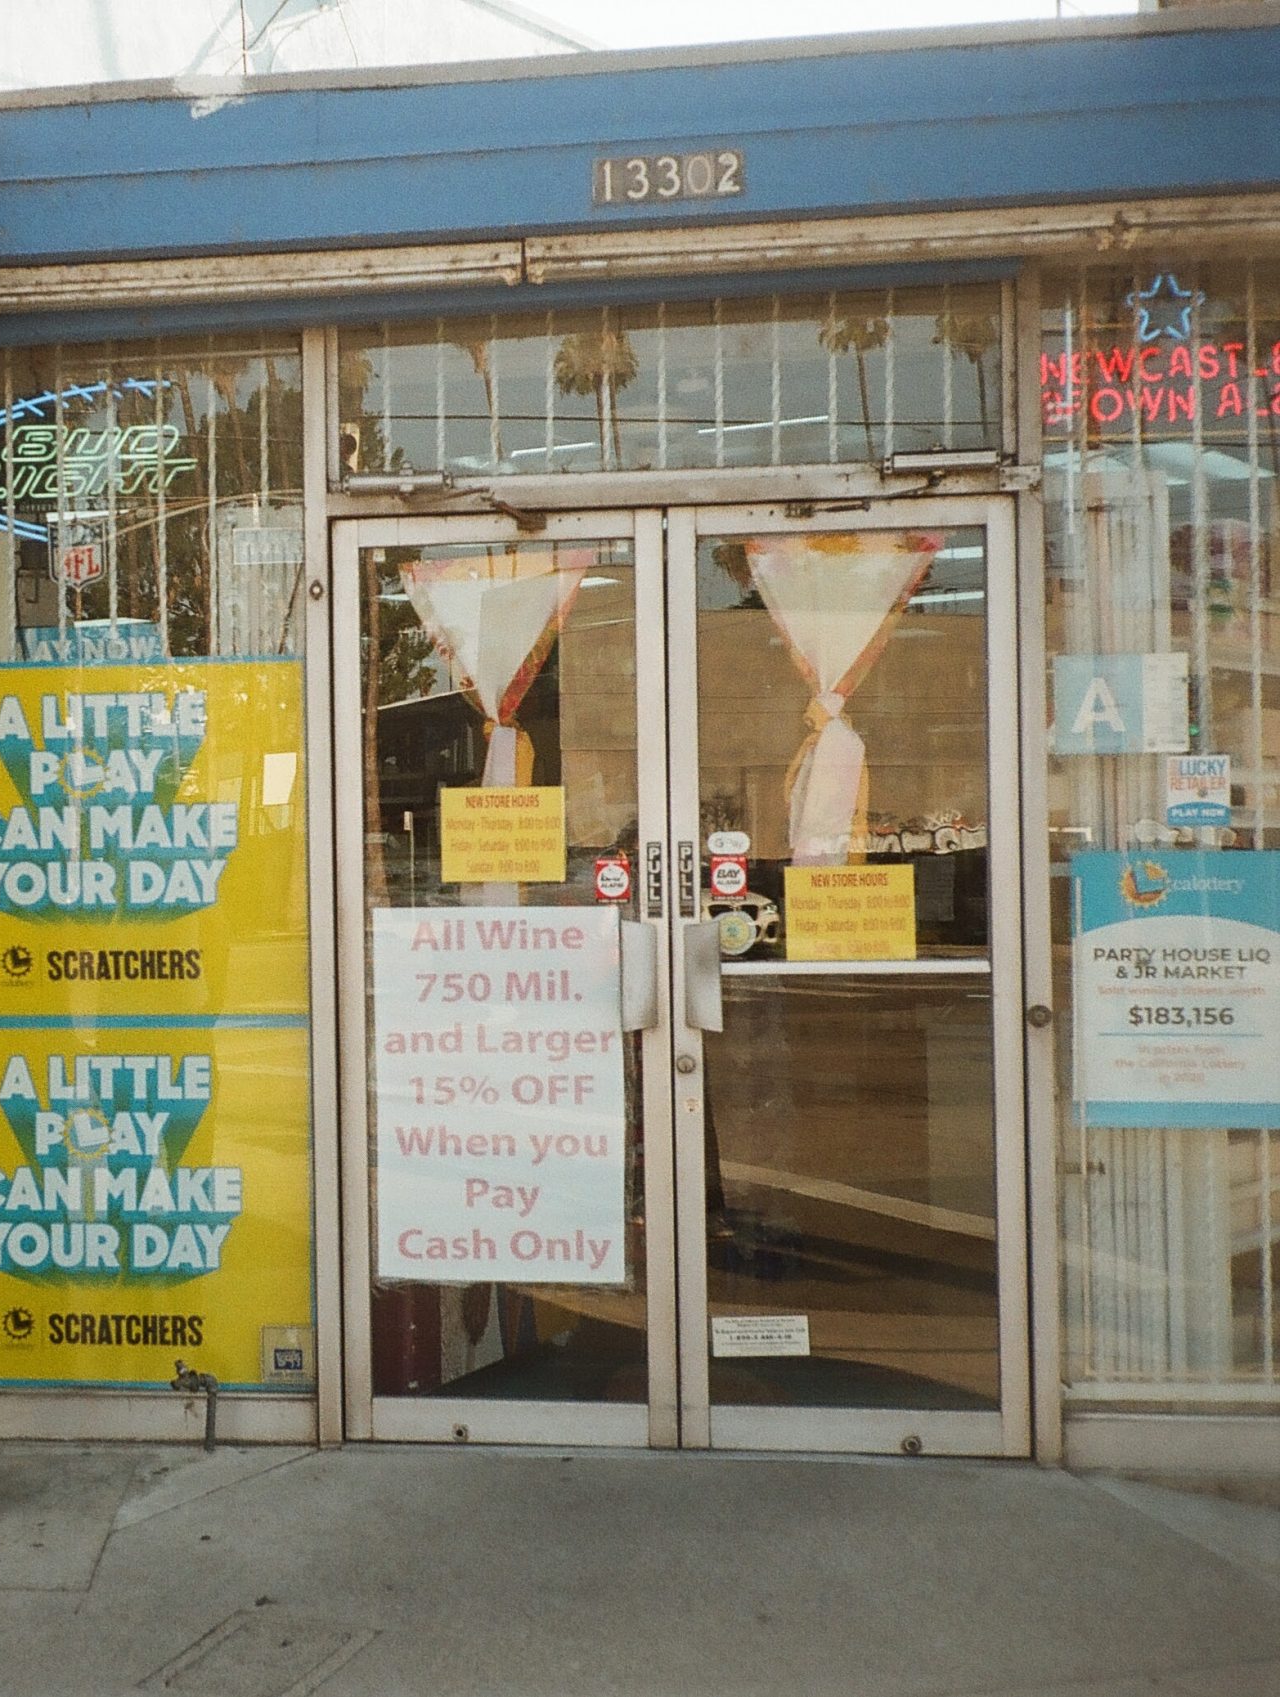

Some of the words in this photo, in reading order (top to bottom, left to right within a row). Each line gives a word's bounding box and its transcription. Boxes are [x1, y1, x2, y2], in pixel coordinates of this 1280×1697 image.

[603, 152, 741, 201] 13302
[1, 424, 179, 462] BUD
[41, 690, 207, 738] LITTLE
[1070, 677, 1126, 734] A
[30, 749, 164, 795] PLAY
[1179, 758, 1227, 777] LUCKY
[465, 795, 483, 809] NEW
[485, 794, 510, 808] STORE
[511, 794, 539, 808] HOURS
[88, 802, 238, 849] MAKE
[129, 858, 227, 905] DAY
[648, 847, 661, 901] PULL
[679, 846, 693, 901] PULL
[811, 874, 831, 888] NEW
[832, 873, 858, 887] STORE
[859, 873, 888, 887] HOURS
[410, 919, 467, 952] All
[474, 918, 586, 951] Wine
[47, 949, 201, 981] SCRATCHERS
[1093, 947, 1154, 963] PARTY
[1162, 947, 1232, 963] HOUSE
[1238, 947, 1271, 965] LIQ
[1115, 965, 1129, 980] &
[1134, 965, 1158, 980] JR
[1163, 965, 1248, 980] MARKET
[415, 972, 493, 1003] 750
[504, 969, 584, 1003] Mil.
[1128, 1003, 1235, 1028] $183,156
[383, 1022, 464, 1055] and
[476, 1021, 617, 1062] Larger
[48, 1054, 212, 1100] LITTLE
[407, 1075, 501, 1106] 15%
[510, 1073, 596, 1106] OFF
[35, 1111, 170, 1156] PLAY
[394, 1124, 518, 1158] When
[528, 1131, 610, 1167] you
[94, 1166, 243, 1213] MAKE
[464, 1177, 541, 1218] Pay
[133, 1223, 231, 1269] DAY
[396, 1228, 499, 1262] Cash
[509, 1228, 612, 1270] Only
[48, 1314, 204, 1347] SCRATCHERS
